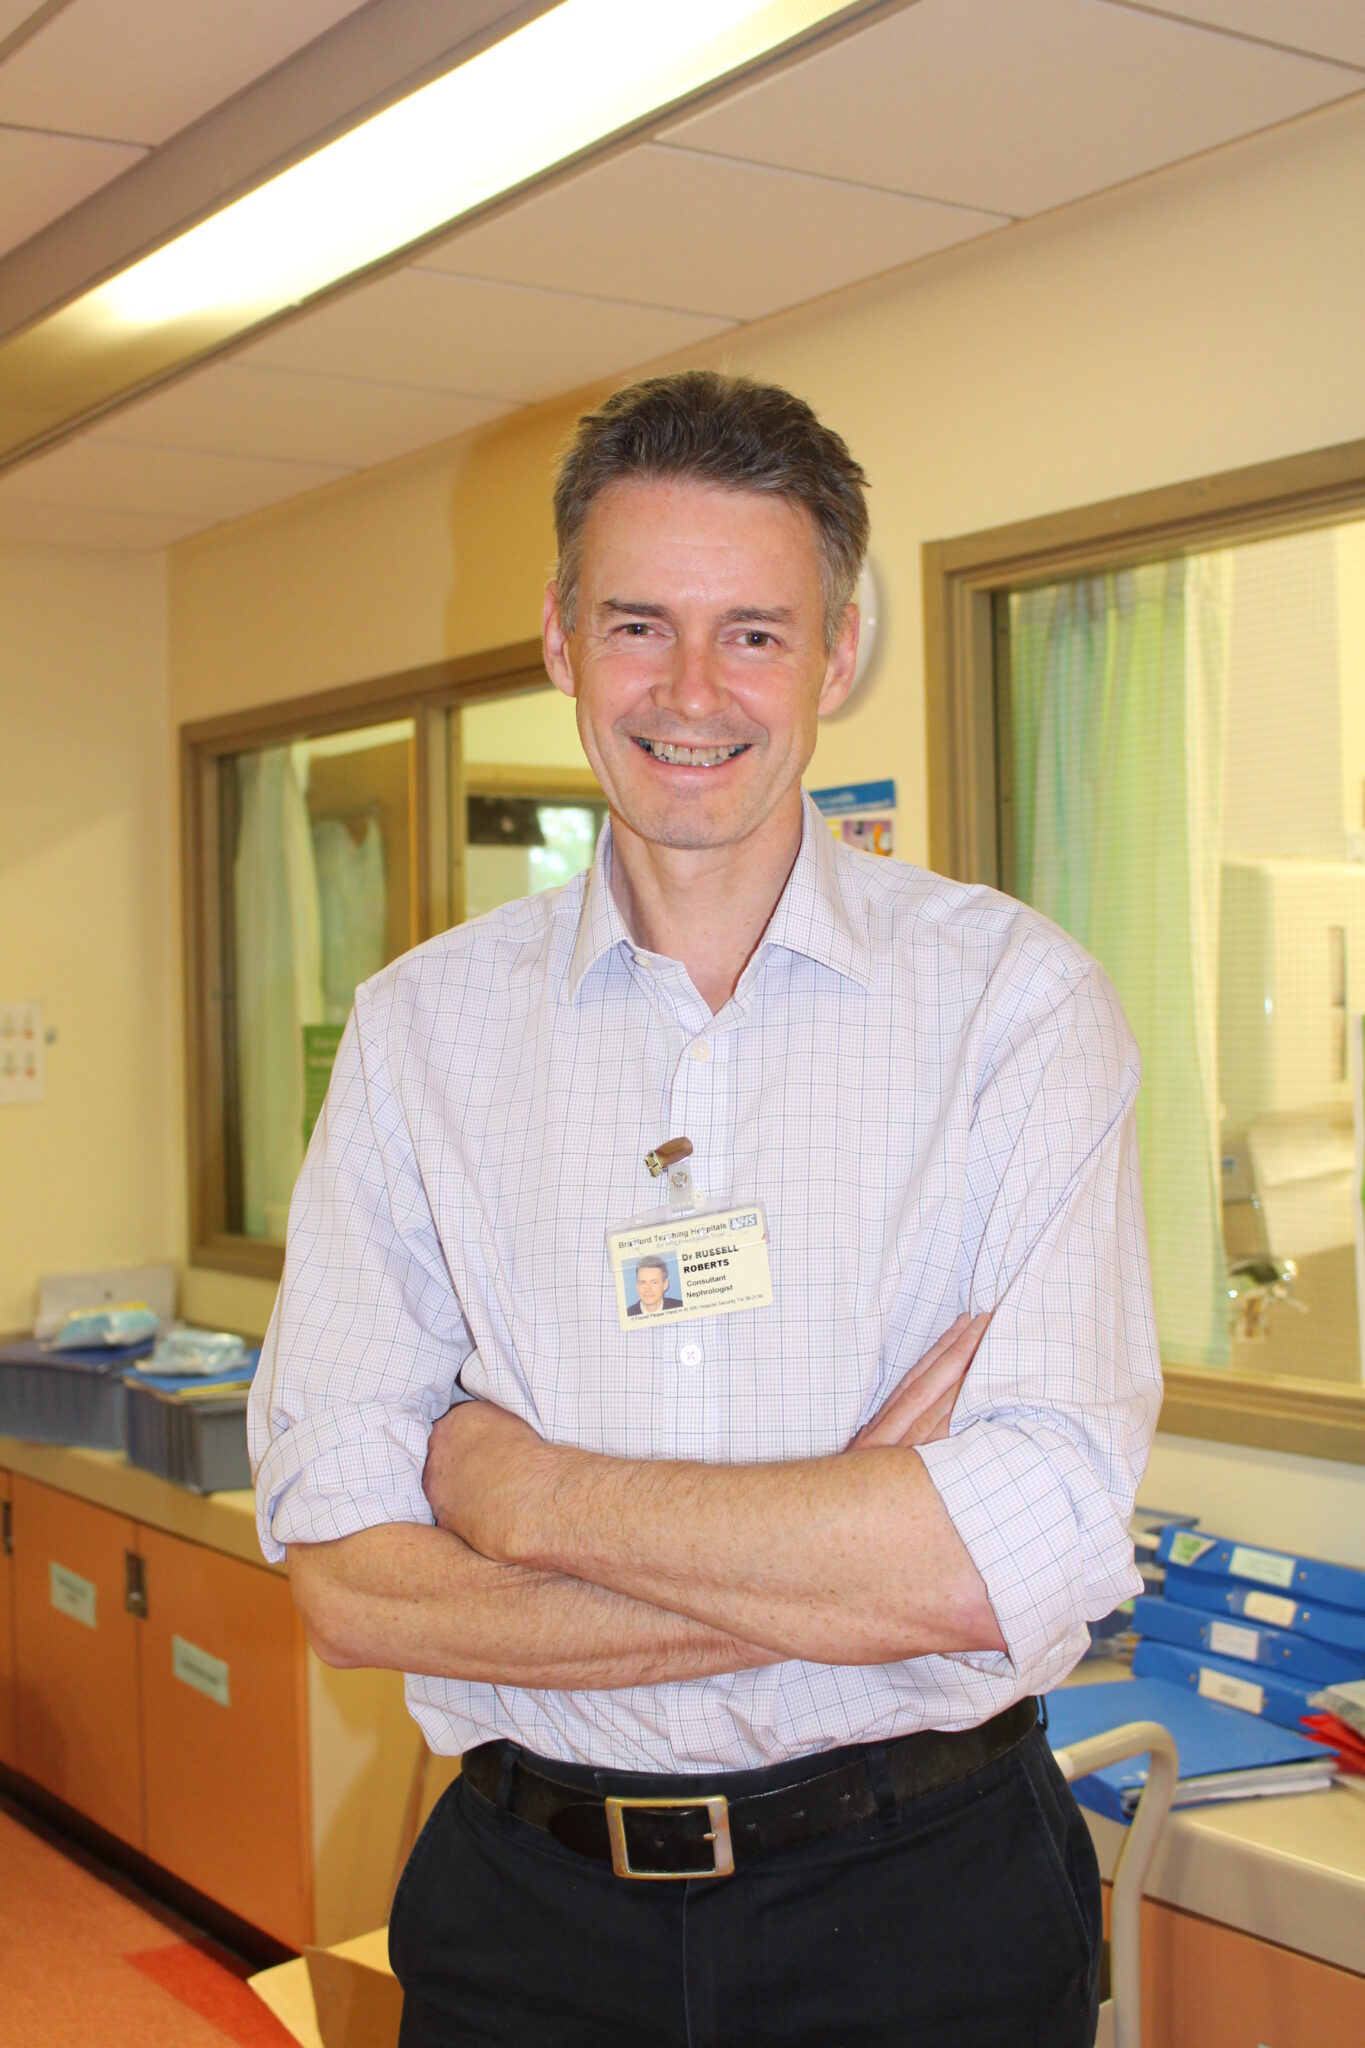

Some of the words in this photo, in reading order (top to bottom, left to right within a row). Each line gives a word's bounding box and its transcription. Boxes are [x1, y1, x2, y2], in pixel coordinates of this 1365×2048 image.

[729, 1214, 757, 1229] NHS
[682, 1253, 693, 1261] Dr
[695, 1244, 739, 1259] RUSSELL
[683, 1259, 729, 1273] ROBERTS
[687, 1274, 726, 1287] Consultant
[686, 1284, 733, 1299] Nephrologist
